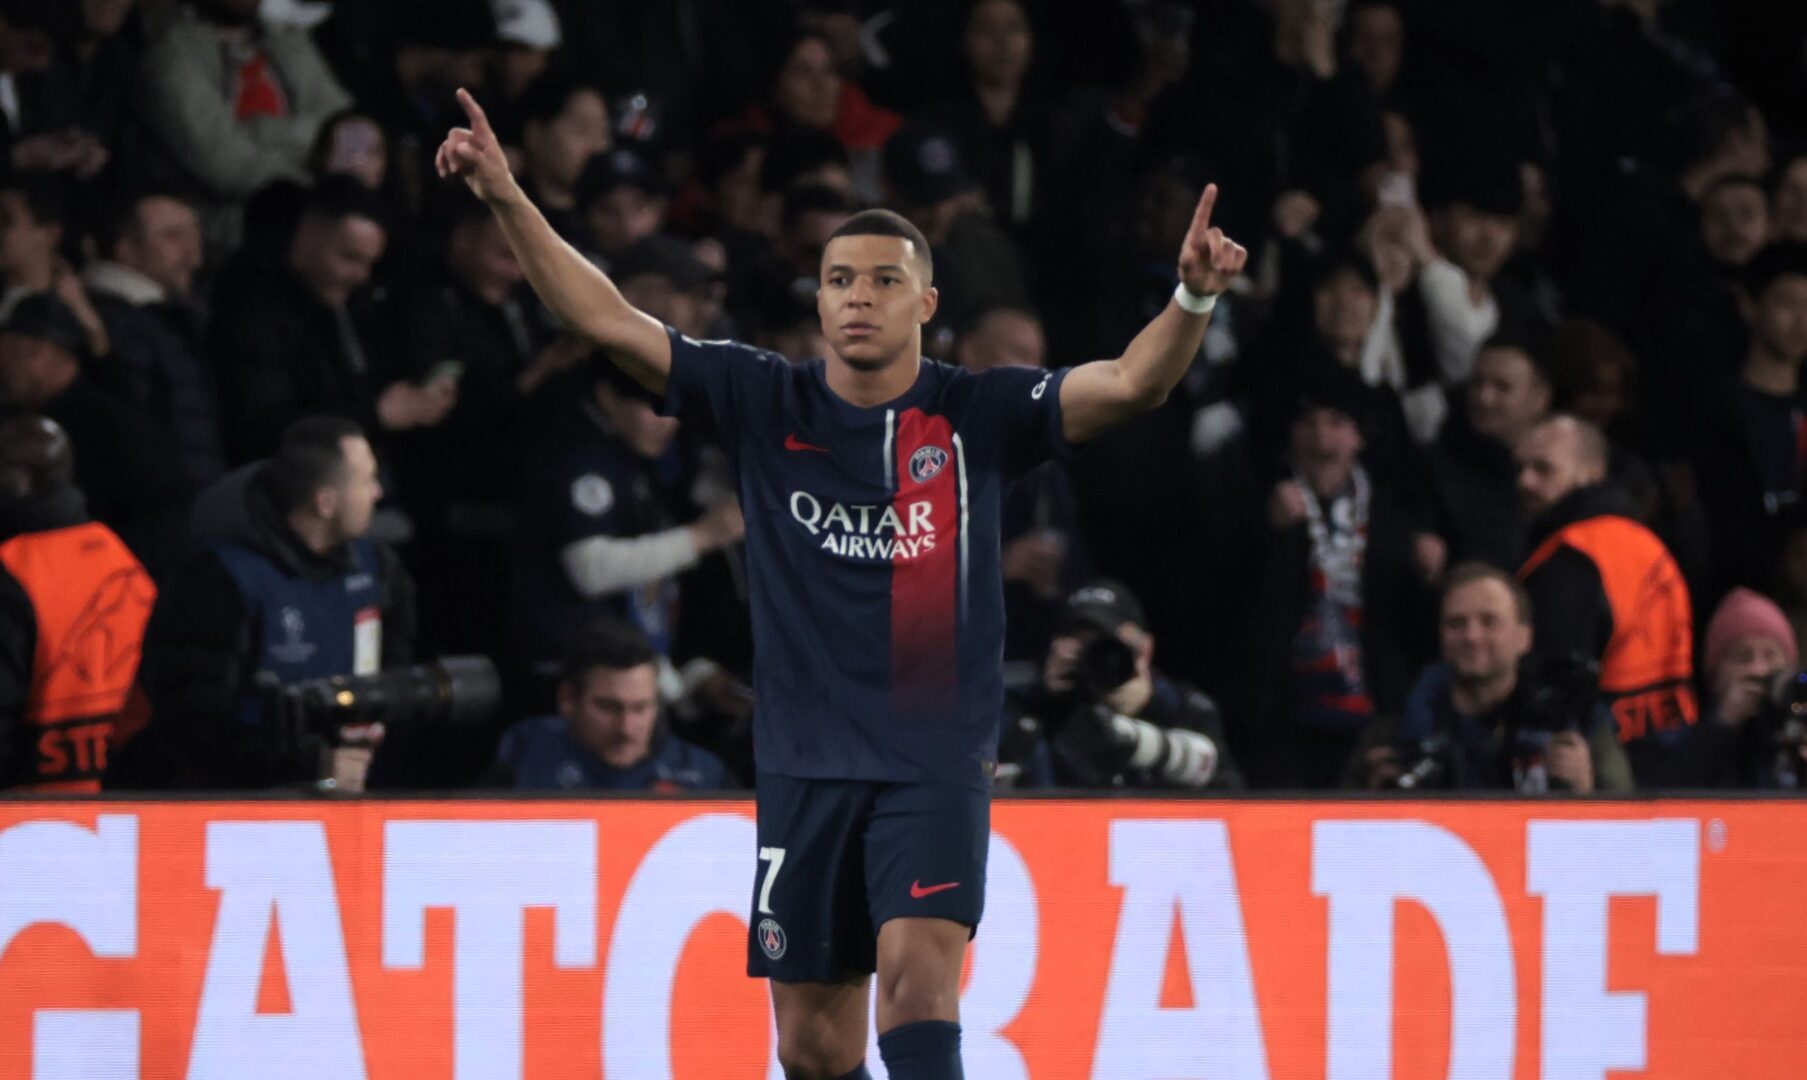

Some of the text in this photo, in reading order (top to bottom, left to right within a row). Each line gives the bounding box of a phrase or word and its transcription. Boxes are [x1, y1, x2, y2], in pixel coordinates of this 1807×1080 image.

[790, 491, 935, 536] QATAR
[821, 532, 936, 560] AIRWAYS
[759, 846, 786, 914] 7
